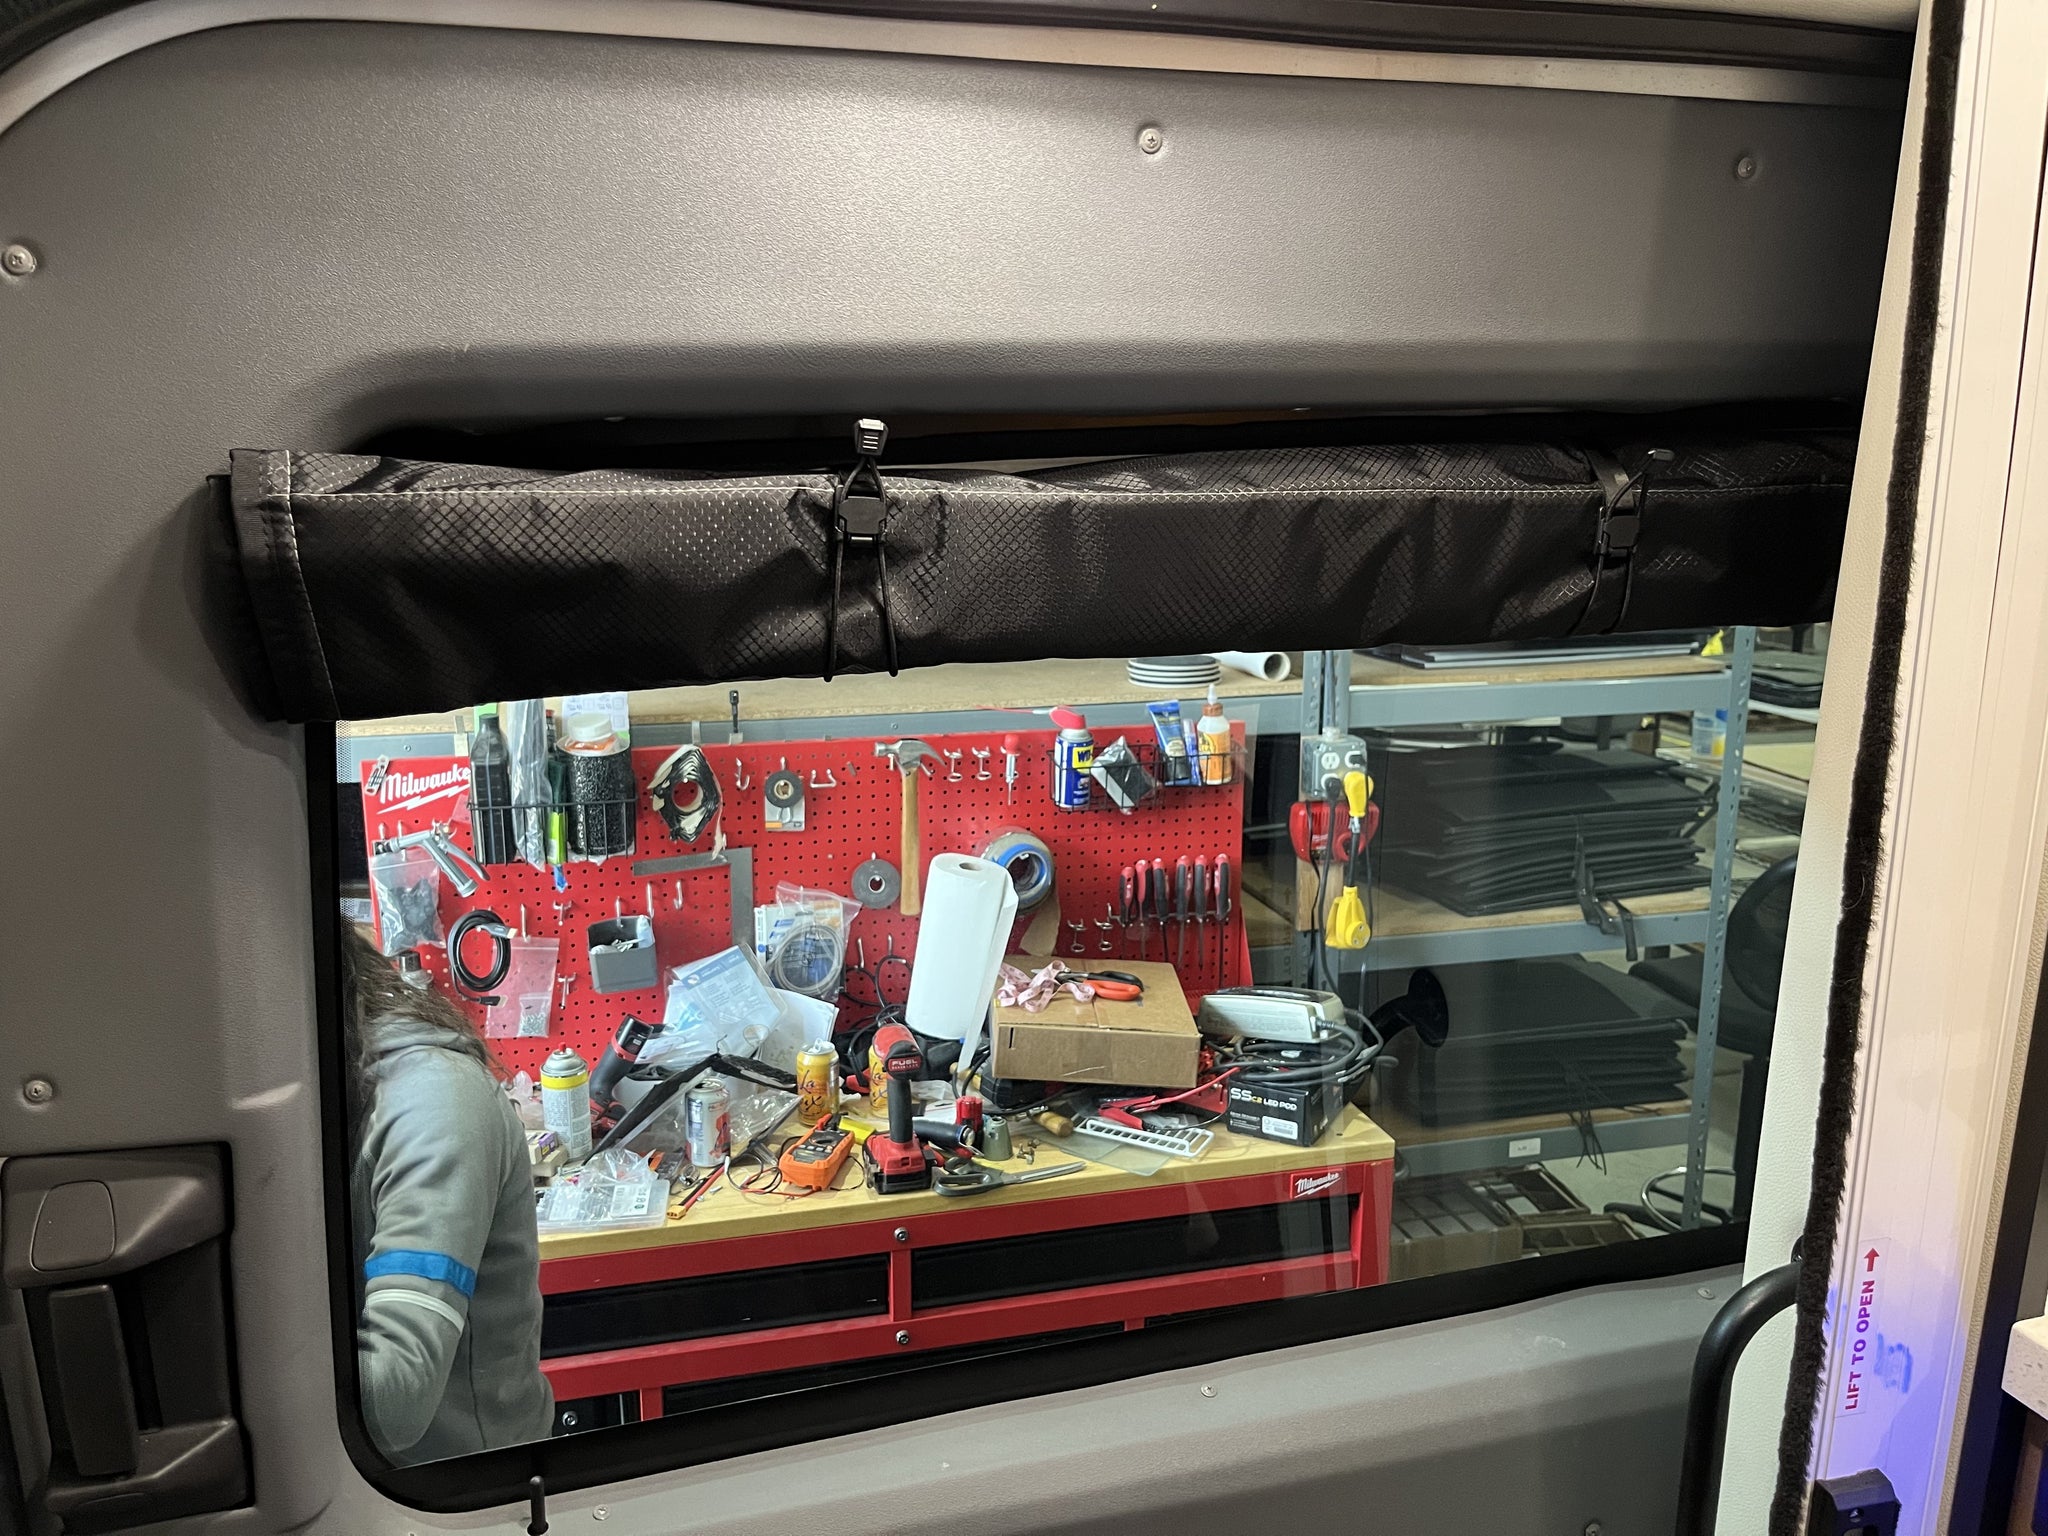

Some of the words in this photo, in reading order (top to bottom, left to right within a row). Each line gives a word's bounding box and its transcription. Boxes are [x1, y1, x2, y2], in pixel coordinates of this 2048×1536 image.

[379, 763, 471, 804] Milwauke
[1263, 1098, 1279, 1107] LED
[1279, 1101, 1298, 1111] POD
[1294, 1172, 1340, 1194] Milwaukee
[1856, 1280, 1875, 1333] OPEN
[1851, 1338, 1867, 1365] TO
[1845, 1371, 1862, 1410] LIFT
